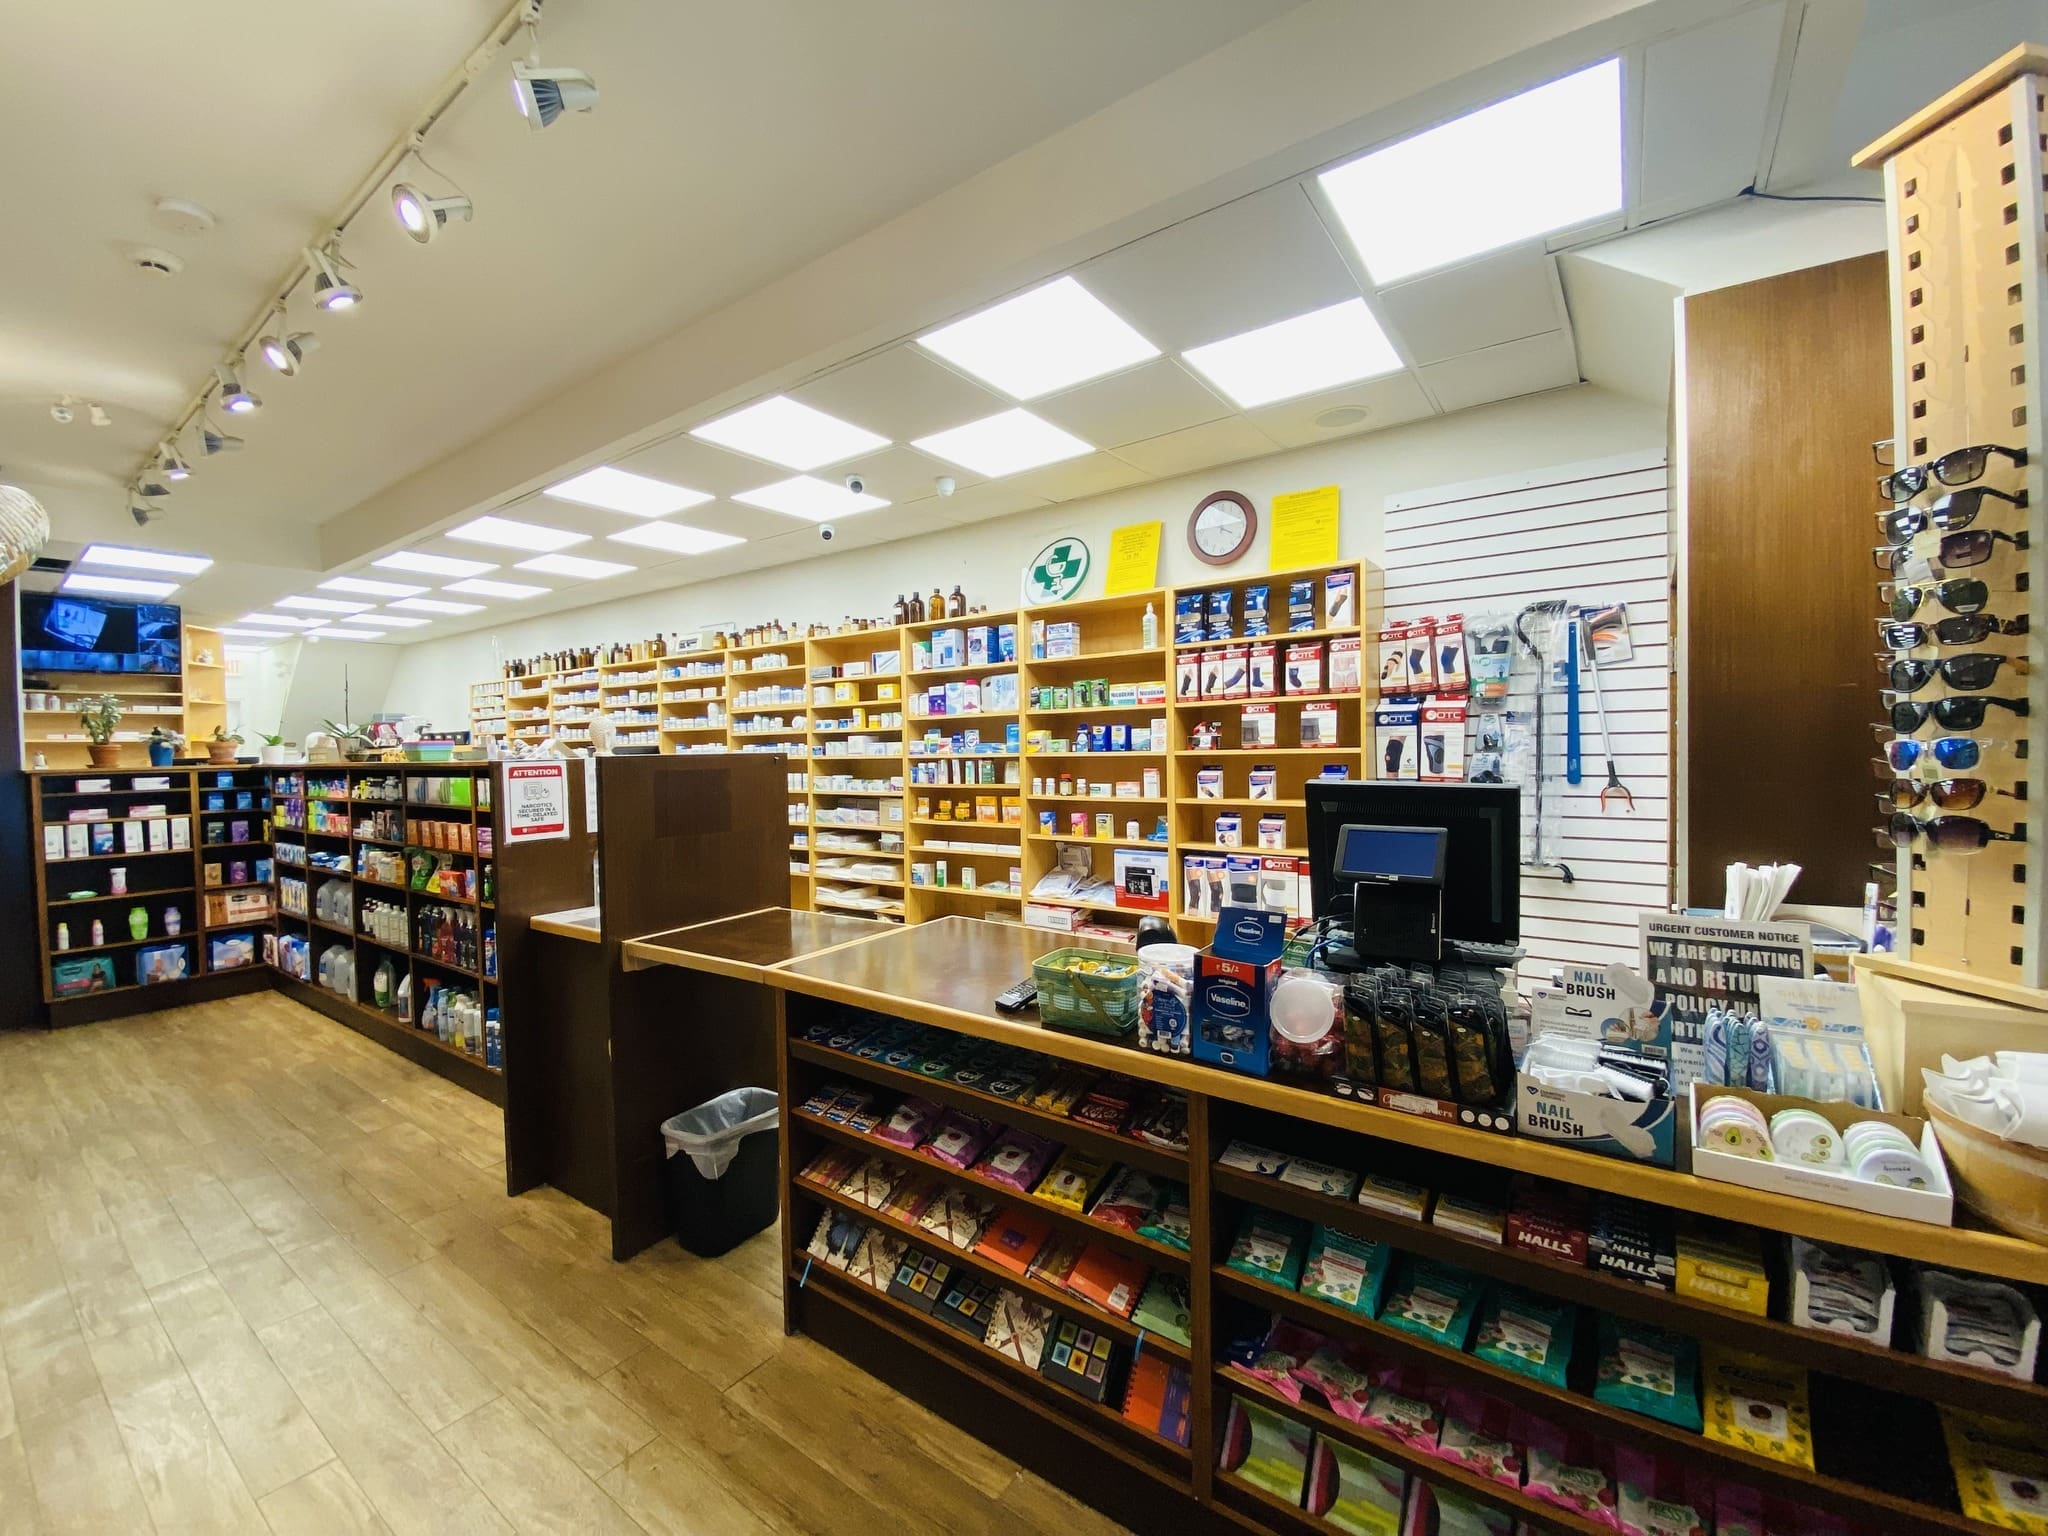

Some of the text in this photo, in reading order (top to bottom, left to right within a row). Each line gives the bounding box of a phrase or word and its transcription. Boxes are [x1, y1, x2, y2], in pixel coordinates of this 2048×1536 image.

[1412, 628, 1427, 637] OTC
[1442, 625, 1459, 633] OTC
[1388, 632, 1403, 640] OTC
[1339, 641, 1360, 650] OTC
[1296, 651, 1315, 660] OTC
[1252, 705, 1270, 713] OTC
[1436, 711, 1462, 720] OTC
[1388, 713, 1413, 724] OTC
[512, 768, 559, 777] ATTENTION
[516, 811, 558, 819] TIME-DELAYED
[1272, 861, 1293, 870] OTC
[1237, 925, 1261, 935] Vaseline
[1648, 922, 1800, 944] URGENT CUSTOMER NOTICE
[1648, 941, 1801, 971] WE ARE OPERATING
[1573, 970, 1607, 986] NAIL
[1655, 969, 1667, 984] A
[1670, 966, 1698, 988] NO
[1566, 983, 1616, 1001] BRUSH
[1210, 992, 1247, 1009] Vaseline
[1665, 993, 1728, 1013] POLICY
[1680, 1046, 1693, 1054] We
[1536, 1101, 1575, 1121] NAIL
[1528, 1114, 1584, 1137] BRUSH
[1518, 1231, 1573, 1256] HALLS
[1612, 1243, 1651, 1260] HALLS
[1600, 1254, 1659, 1279] HALLS
[1689, 1278, 1751, 1302] HALLS
